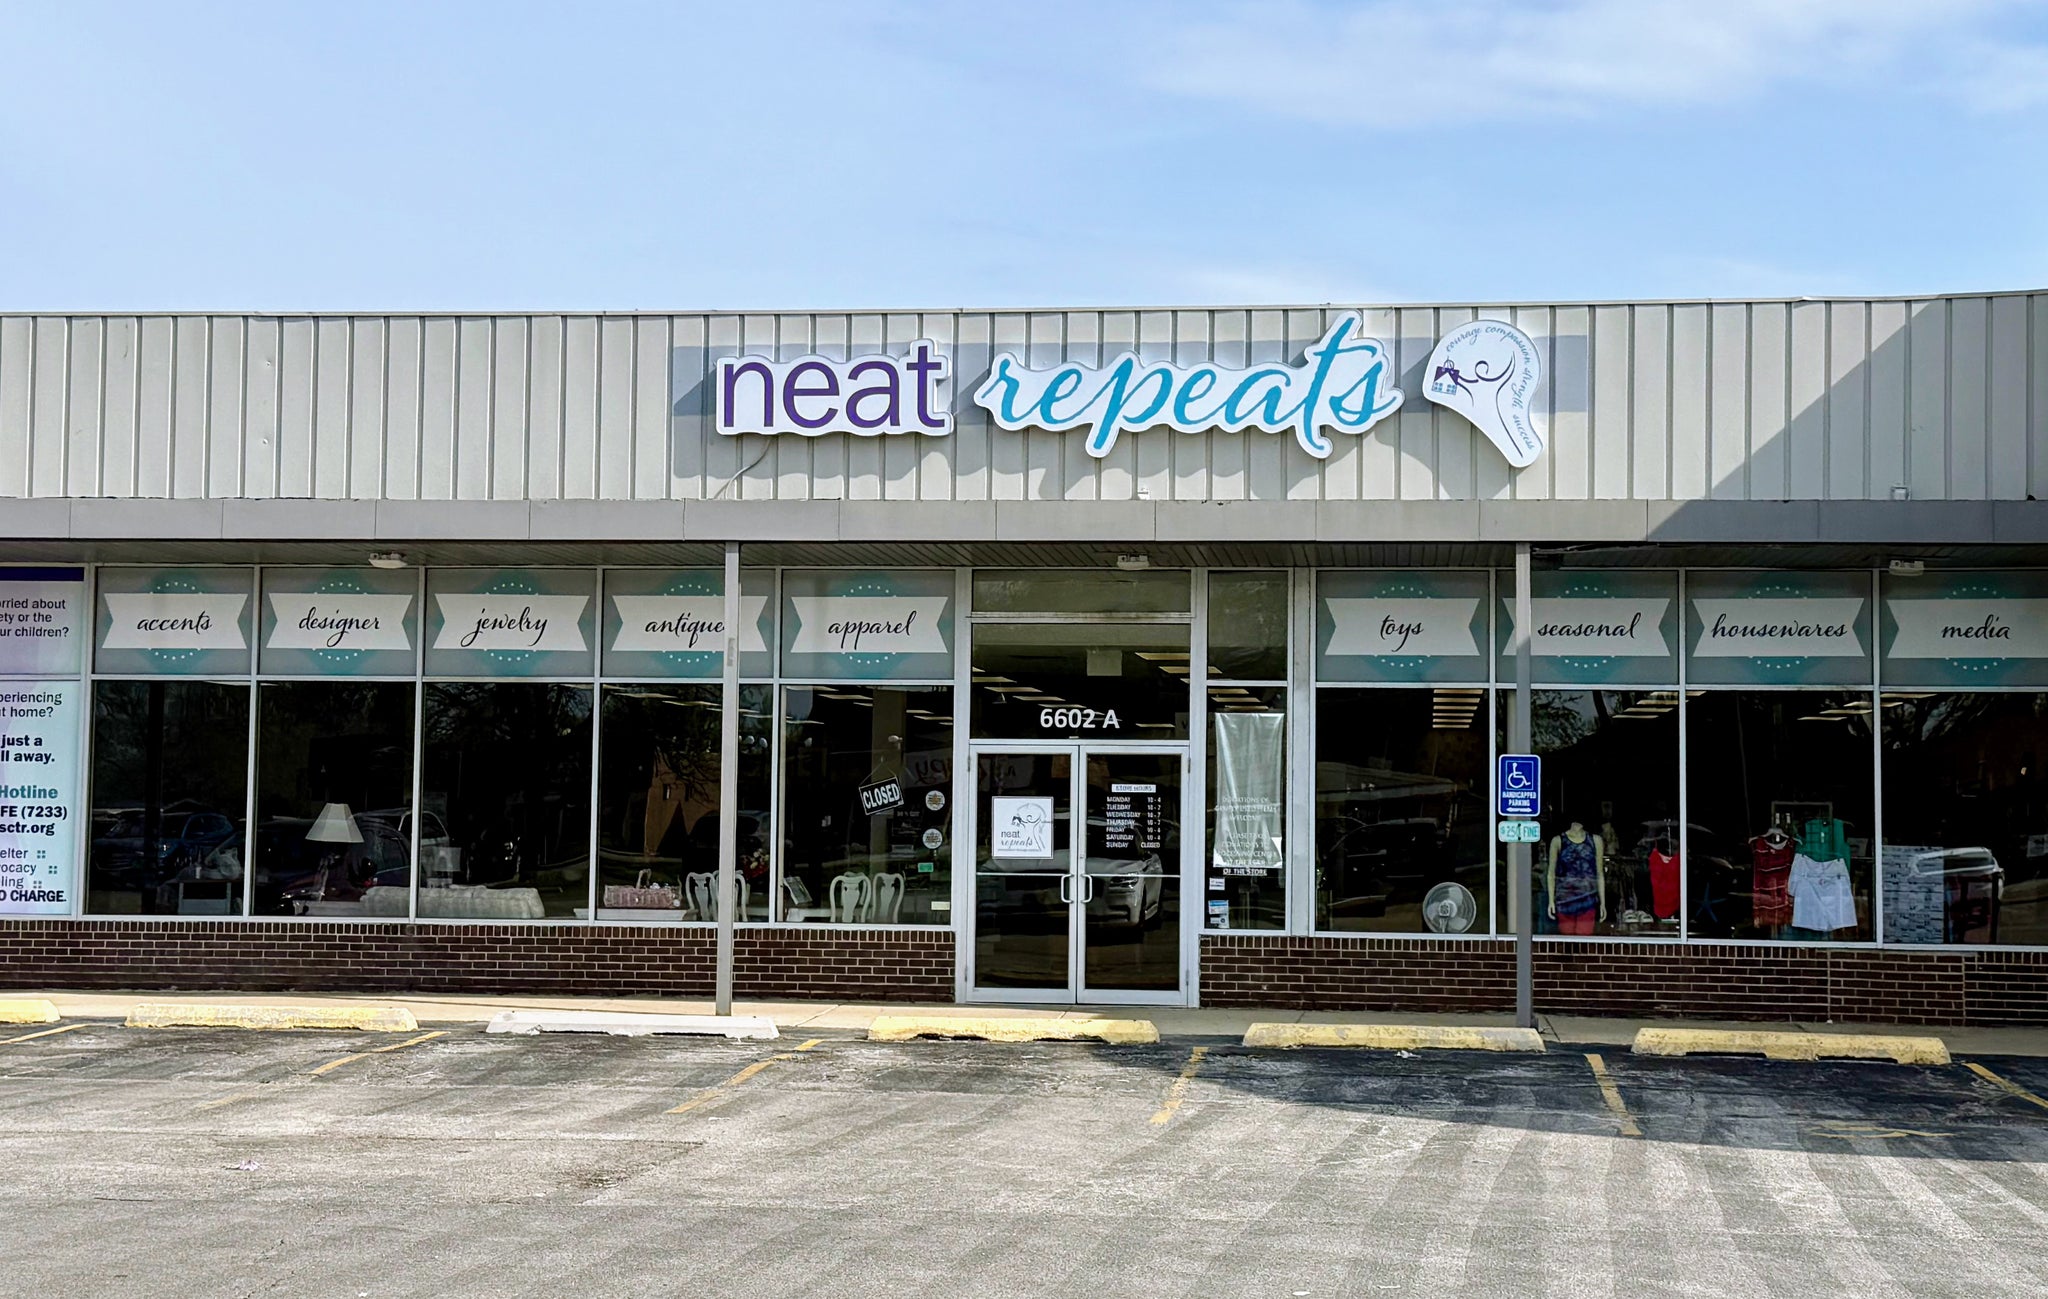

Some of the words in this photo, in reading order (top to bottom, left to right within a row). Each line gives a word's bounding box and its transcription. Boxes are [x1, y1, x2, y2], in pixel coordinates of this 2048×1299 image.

[1446, 327, 1482, 353] courage
[1485, 326, 1531, 364] compassion
[723, 345, 945, 429] neat
[981, 316, 1399, 451] repeats
[1511, 367, 1534, 409] strength
[1512, 414, 1535, 450] success
[0, 598, 28, 609] rried
[31, 598, 66, 609] about
[18, 614, 30, 623] or
[33, 612, 53, 623] the
[136, 610, 213, 635] accents
[1537, 612, 1642, 639] seasonal
[1711, 613, 1848, 639] housewares
[14, 626, 69, 638] children?
[298, 606, 380, 648] designer
[460, 606, 548, 648] jewelry
[644, 612, 725, 649] antique
[827, 610, 917, 650] apparel
[1379, 614, 1424, 653] toys
[1941, 614, 2011, 640] media
[0, 706, 6, 717] t
[10, 706, 54, 718] home?
[1040, 708, 1096, 728] 6602
[1102, 709, 1120, 729] A
[0, 734, 30, 749] just
[33, 737, 43, 746] a
[1, 750, 10, 762] ll
[13, 752, 56, 765] away.
[0, 784, 59, 799] Hotline
[862, 783, 900, 809] CLOSED
[1502, 791, 1537, 799] HANDICAPPED
[1508, 799, 1531, 807] PARKING
[0, 805, 18, 818] FE
[21, 805, 68, 820] (7233)
[0, 821, 56, 836] sctr.org
[1000, 830, 1020, 838] neat
[1523, 826, 1540, 838] FINE
[0, 847, 29, 859] elter
[0, 863, 37, 876] ocacy
[1, 875, 24, 890] ling
[10, 889, 67, 902] CHARGE.
